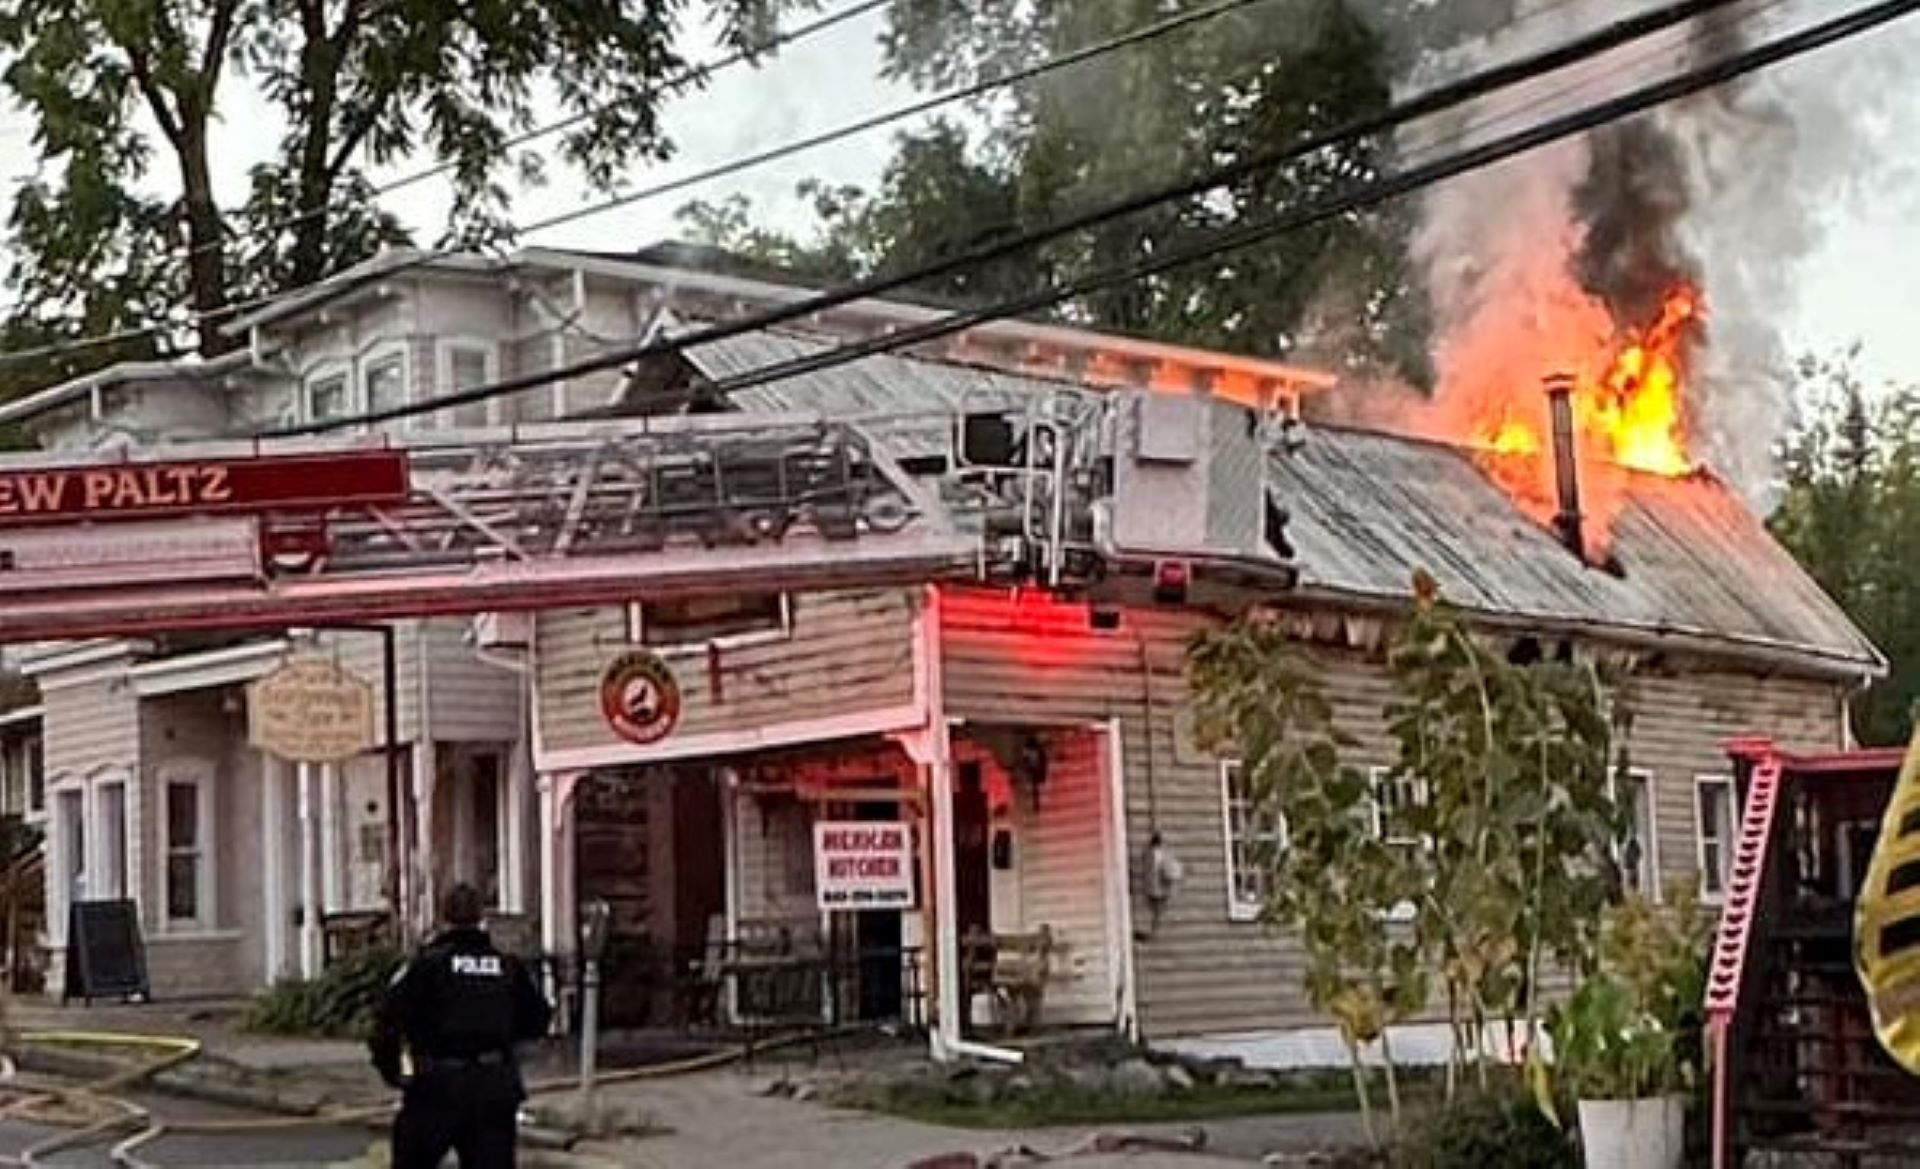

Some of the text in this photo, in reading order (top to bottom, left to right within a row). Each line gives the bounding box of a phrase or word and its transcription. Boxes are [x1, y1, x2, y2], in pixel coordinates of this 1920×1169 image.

[83, 465, 232, 508] PALTZ
[823, 829, 903, 852] MEXICAN
[829, 857, 900, 878] KITCHEN
[451, 955, 502, 975] POLICE
